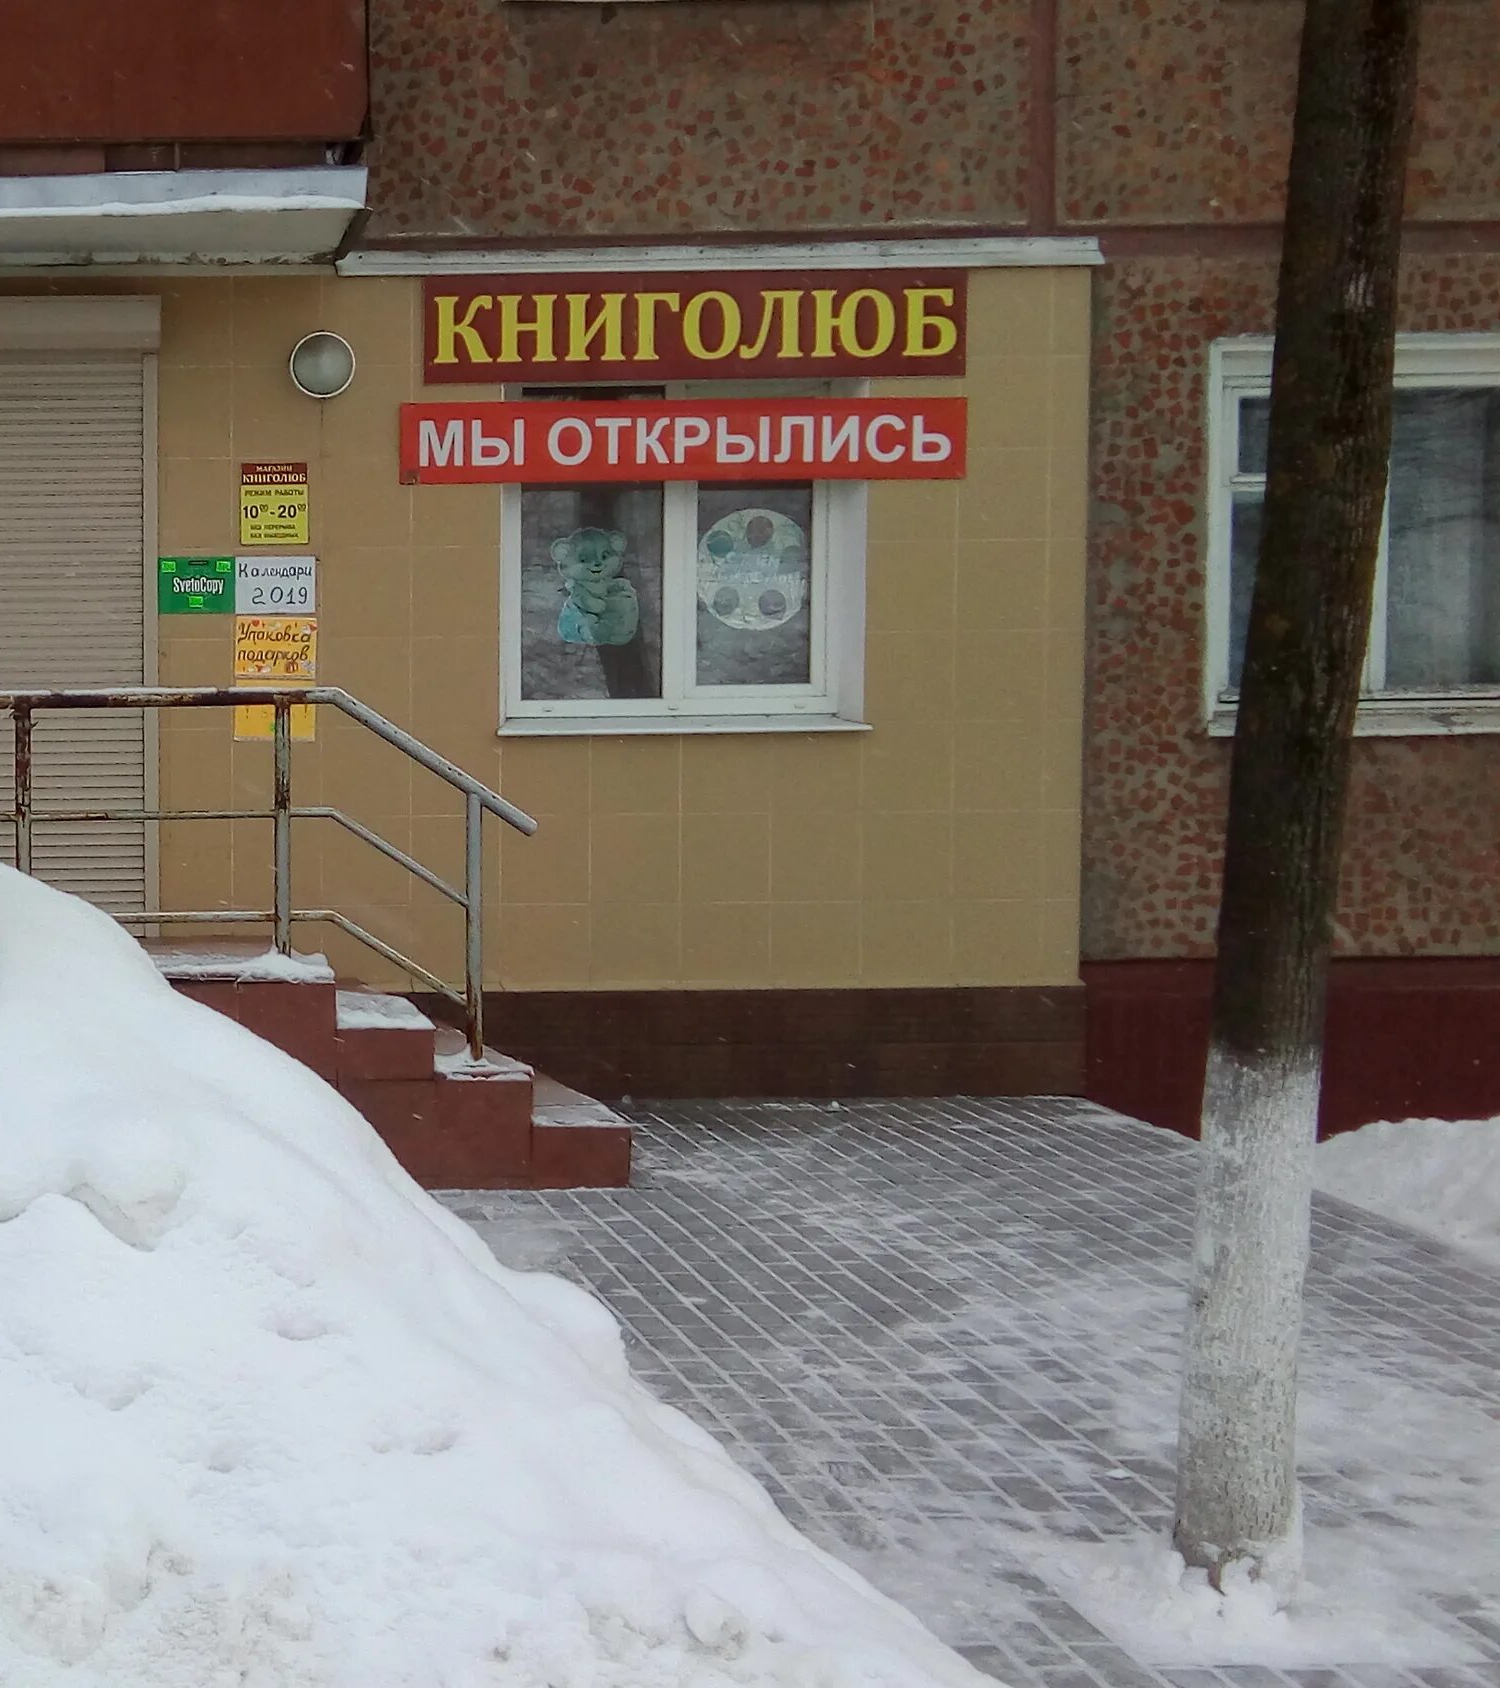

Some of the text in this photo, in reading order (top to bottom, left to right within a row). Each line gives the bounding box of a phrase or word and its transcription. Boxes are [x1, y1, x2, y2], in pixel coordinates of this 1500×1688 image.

[432, 287, 959, 365] КНИГОЛЮБ
[418, 413, 953, 468] МЫ ОТКРЫЛИСЬ
[242, 473, 306, 484] КНИГОЛЮБ
[238, 562, 312, 580] Календари
[173, 576, 224, 595] SvetoCopy
[251, 586, 308, 605] 2019
[237, 622, 311, 645] Упаковка
[237, 645, 311, 667] подарков
